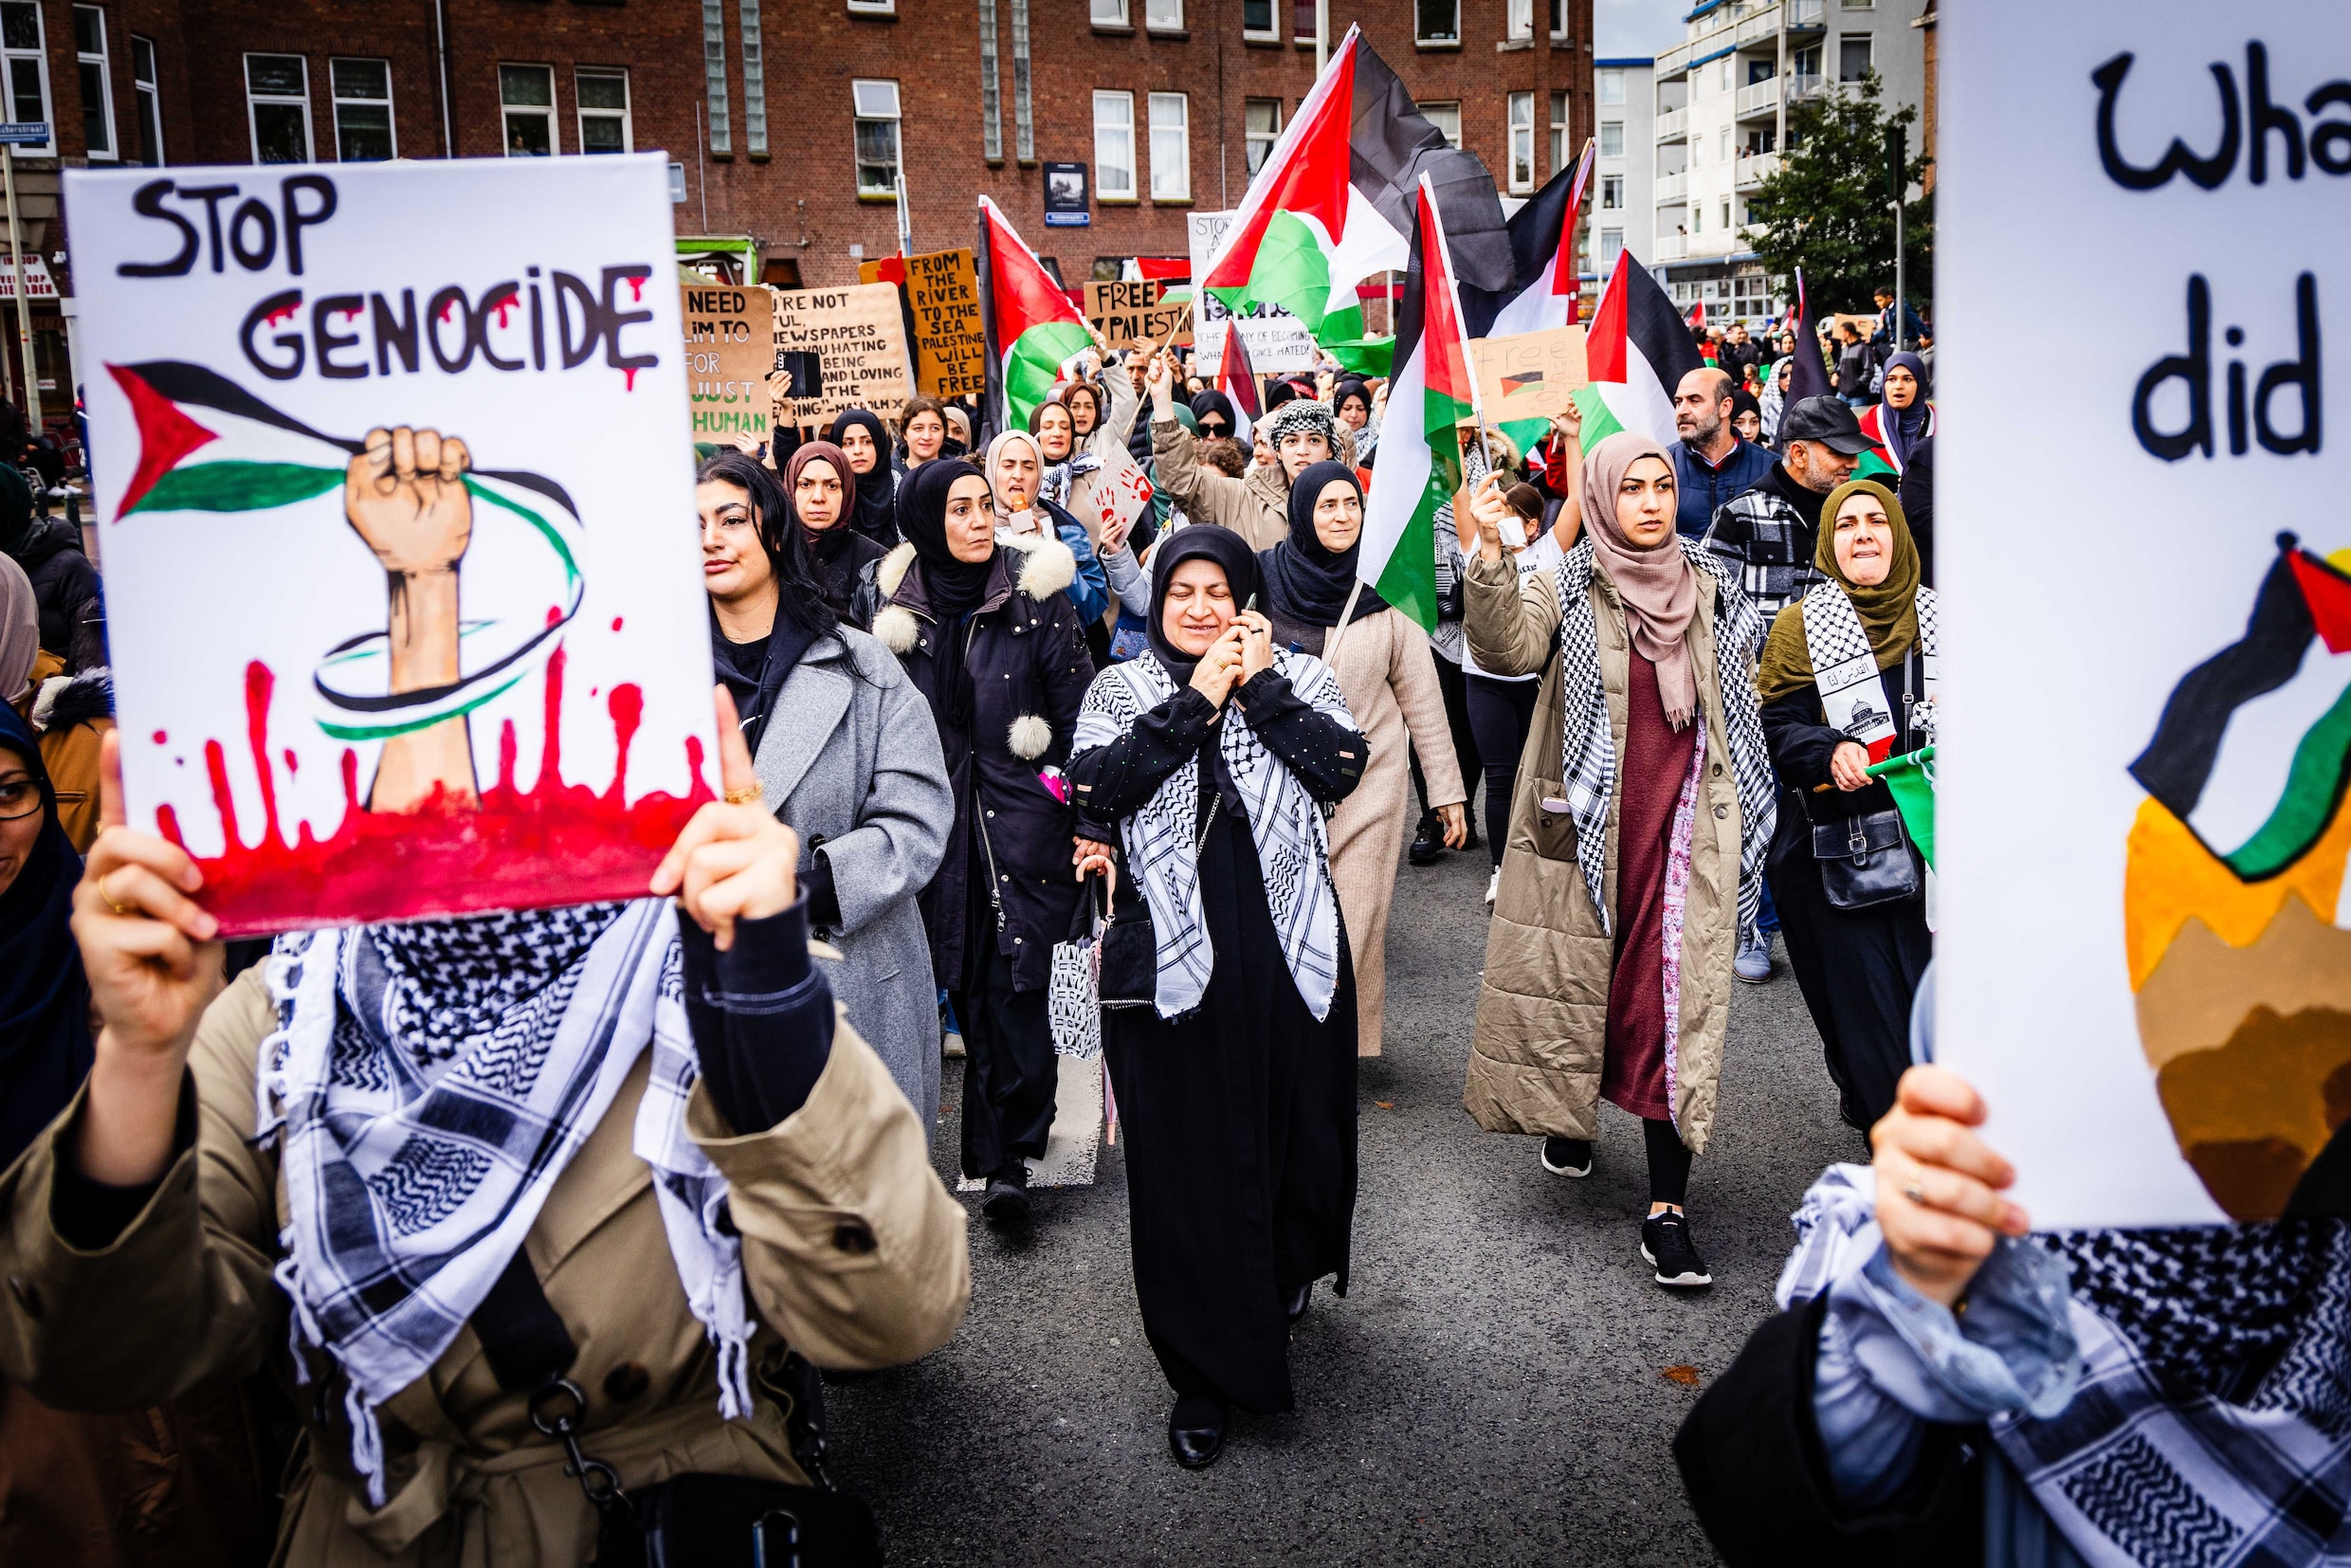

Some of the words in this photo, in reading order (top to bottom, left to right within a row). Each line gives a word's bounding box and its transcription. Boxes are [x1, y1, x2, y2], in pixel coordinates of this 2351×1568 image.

[116, 173, 338, 277] STOP
[910, 252, 960, 276] FROM
[923, 271, 957, 288] THE
[687, 290, 746, 314] NEED
[812, 293, 849, 310] NOT
[1097, 282, 1155, 313] FREE
[920, 306, 941, 321] TO
[945, 303, 979, 319] THE
[719, 320, 750, 343] TO
[930, 319, 965, 335] SEA
[831, 338, 887, 355] HATING
[823, 356, 866, 370] BEING
[947, 362, 968, 375] BE
[2131, 270, 2323, 463] did
[822, 371, 847, 384] AND
[851, 367, 903, 381] LOVING
[938, 374, 984, 394] FREE
[691, 380, 755, 404] JUST
[825, 385, 861, 398] THE
[892, 398, 903, 410] X
[692, 410, 766, 433] HUMAN
